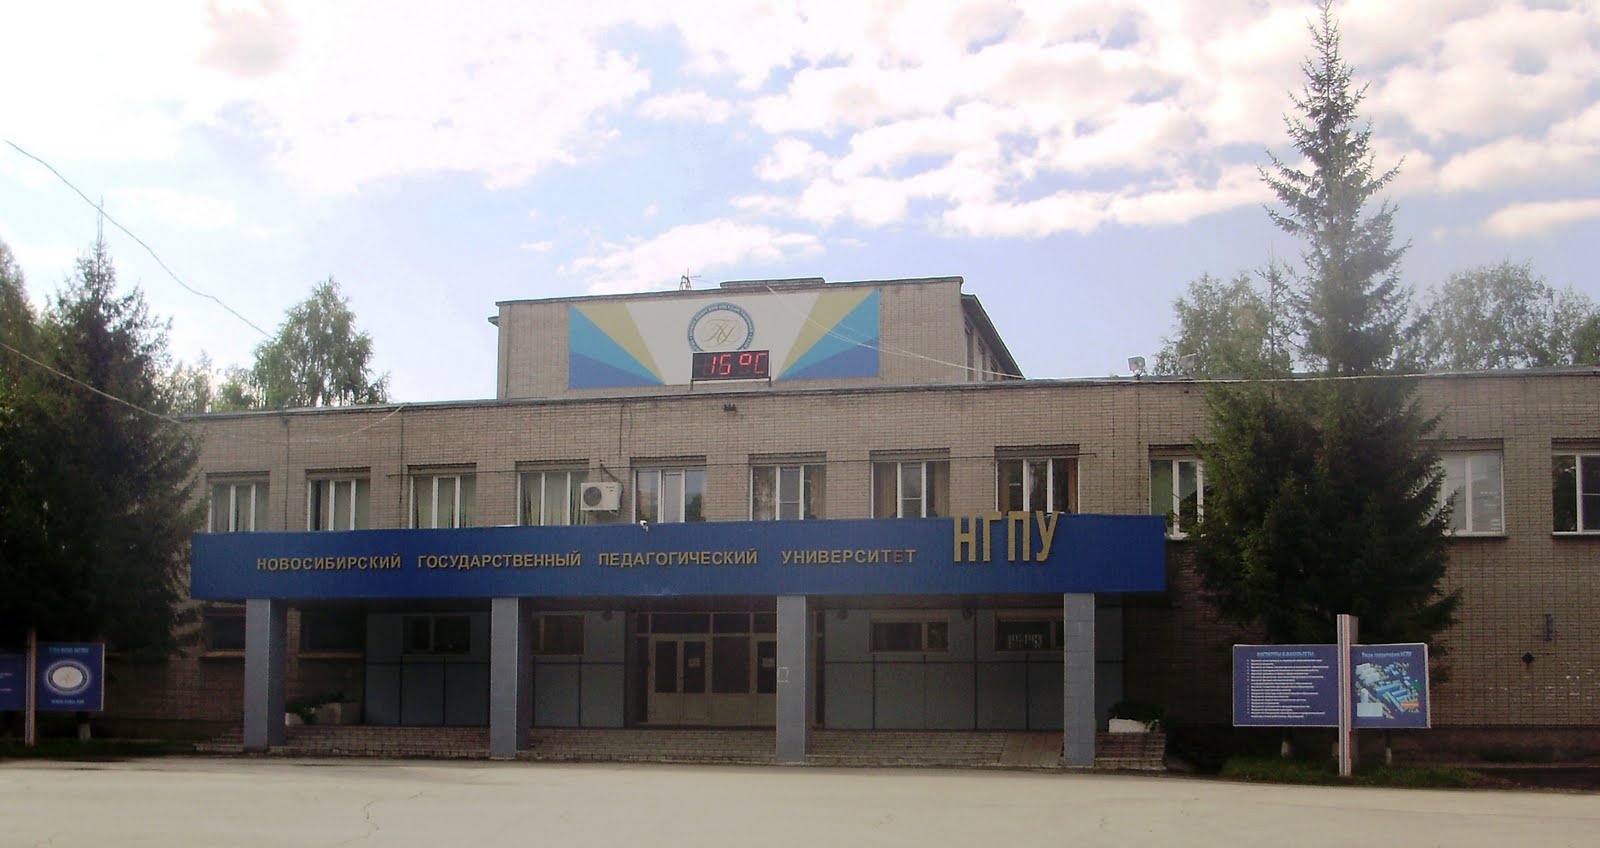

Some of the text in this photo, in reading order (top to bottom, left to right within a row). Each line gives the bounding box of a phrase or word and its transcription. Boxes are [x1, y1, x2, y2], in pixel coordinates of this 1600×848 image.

[953, 510, 1060, 562] НГПУ
[256, 548, 917, 571] НОВОСИБИРСКИЙ ГОСУДАРСТВЕННЫЙ ПЕДАГОГИЧЕСКИЙ УНИВЕРСИТЕТ
